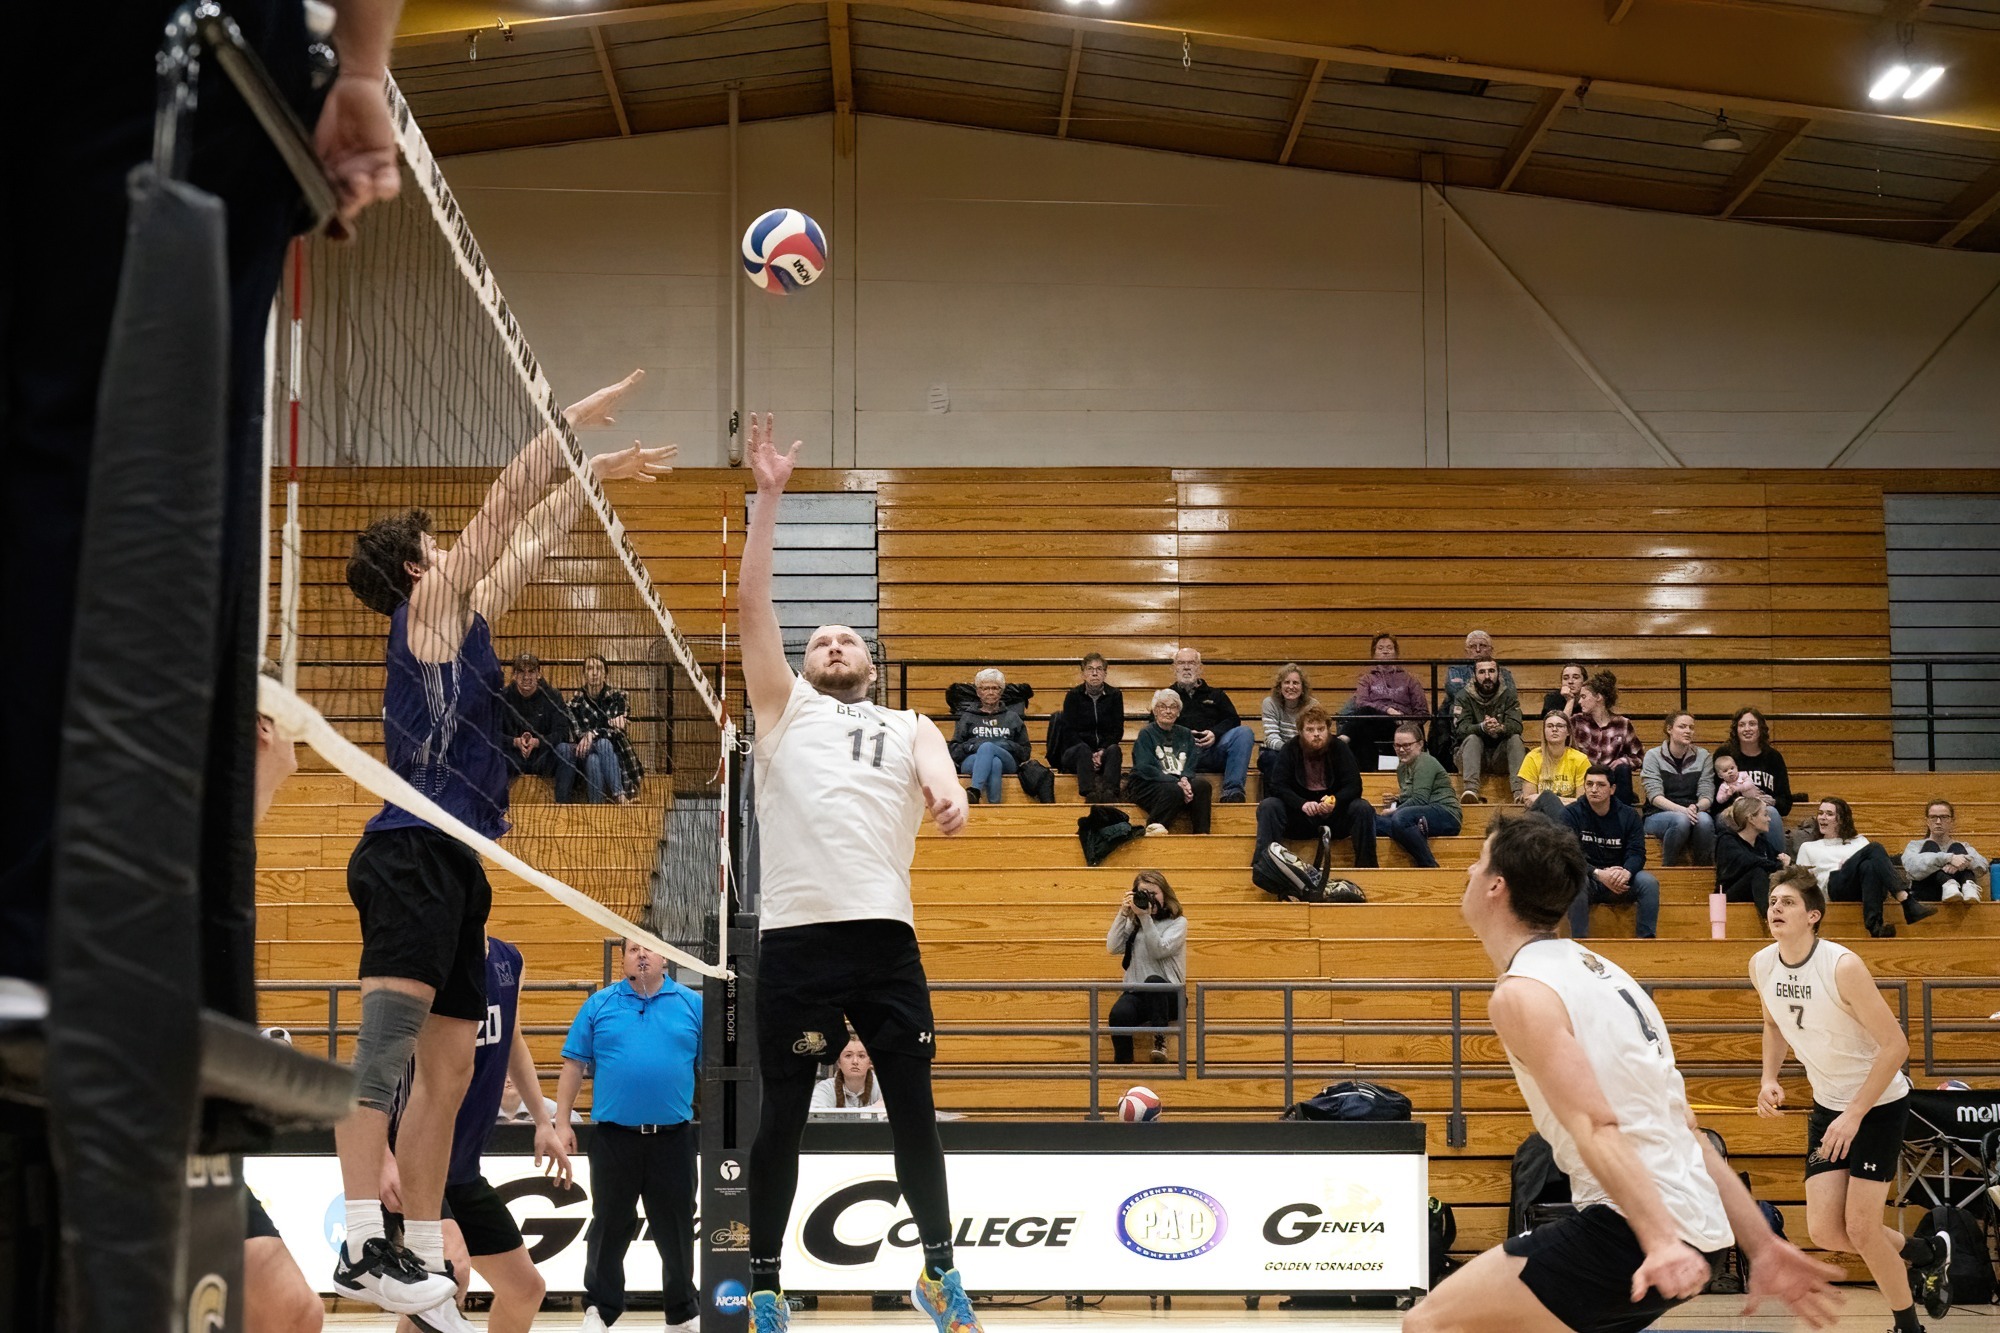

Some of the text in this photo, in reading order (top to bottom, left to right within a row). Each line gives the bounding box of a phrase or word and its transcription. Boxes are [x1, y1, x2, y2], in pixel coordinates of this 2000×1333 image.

[972, 726, 1011, 736] GENEVA
[847, 728, 886, 768] 11
[1746, 770, 1775, 792] NEVA
[727, 963, 736, 998] sorts
[1776, 982, 1812, 1000] GENEVA
[1789, 1004, 1805, 1030] 7
[802, 1179, 1078, 1266] COLEGE
[1139, 1207, 1204, 1240] PAC
[1262, 1202, 1385, 1246] GENEVA
[1264, 1261, 1384, 1272] GOLDEN TORNADOES
[715, 1295, 748, 1307] NCAA
